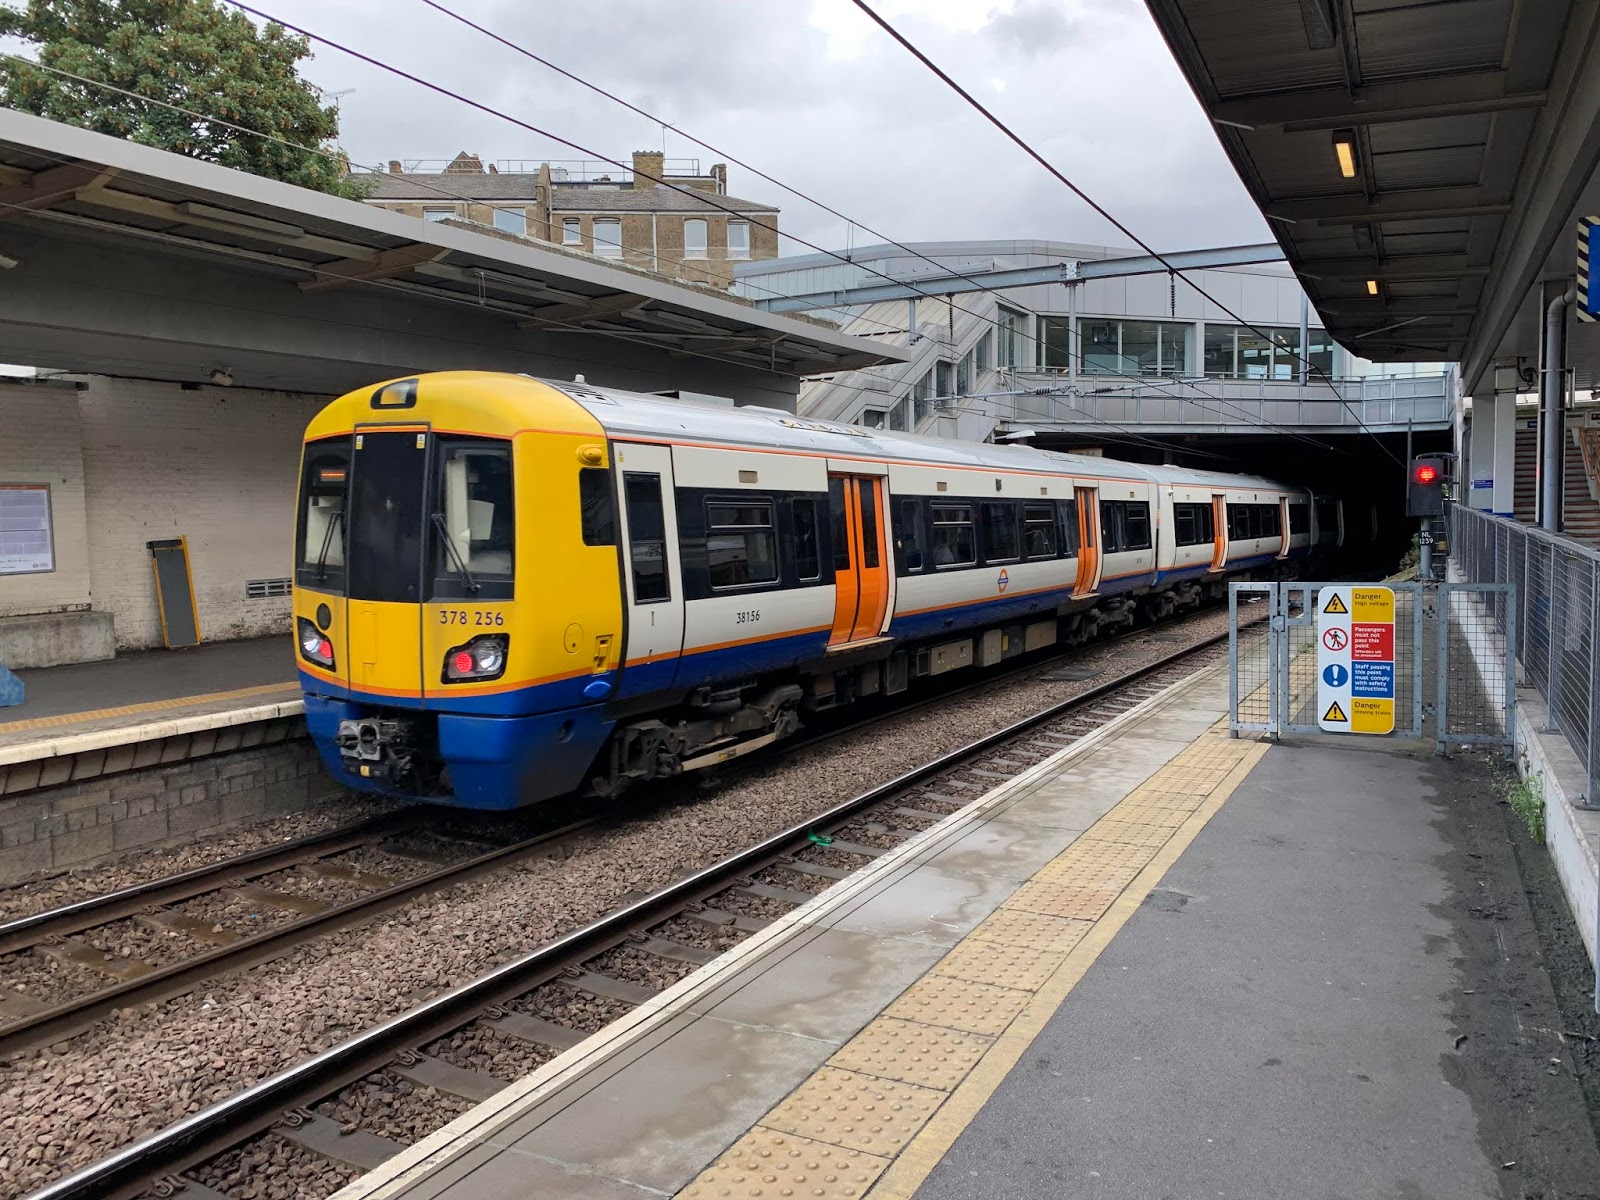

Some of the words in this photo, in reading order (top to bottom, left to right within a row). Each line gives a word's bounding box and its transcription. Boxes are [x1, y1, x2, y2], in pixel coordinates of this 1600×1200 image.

[1355, 593, 1381, 601] Danger
[440, 610, 467, 625] 378
[475, 611, 504, 626] 256
[737, 610, 760, 624] 38156
[1355, 701, 1380, 709] Danger
